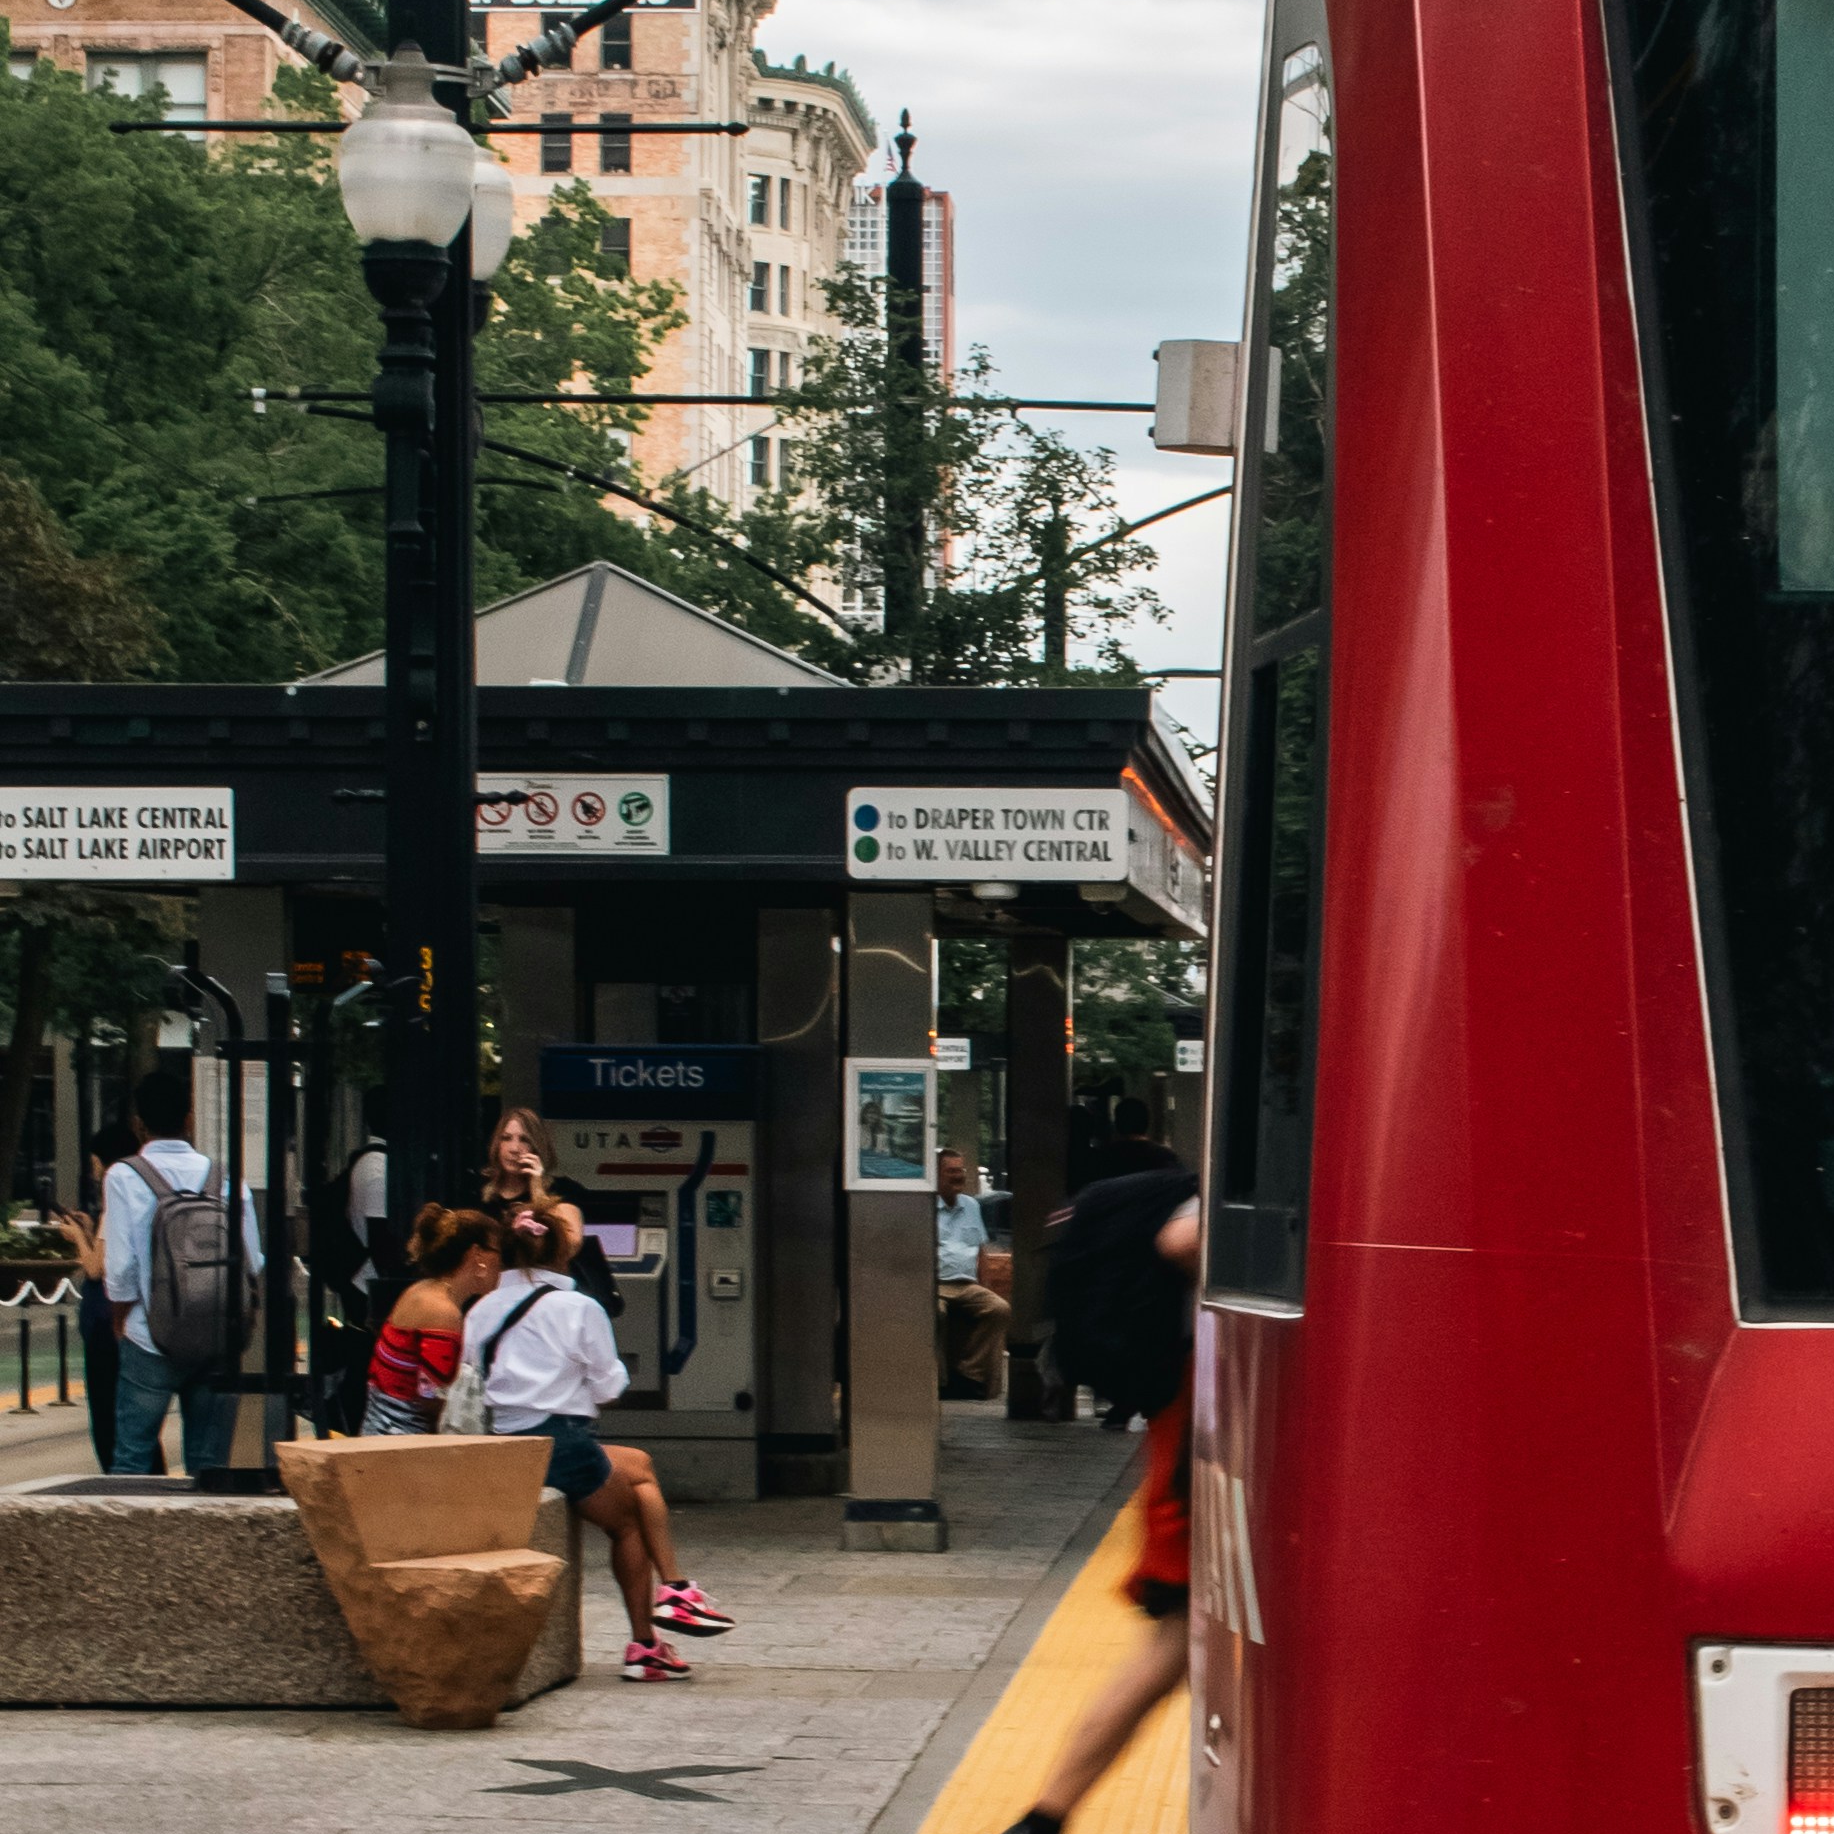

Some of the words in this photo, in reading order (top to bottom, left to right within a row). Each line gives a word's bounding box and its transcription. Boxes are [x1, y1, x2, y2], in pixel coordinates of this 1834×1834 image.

[22, 806, 68, 829] SALT
[76, 806, 129, 829] LAKE
[137, 806, 230, 829] CENTRAL
[887, 811, 908, 829] to
[914, 807, 995, 830] DRAPER
[1000, 808, 1066, 830] TOWN
[1072, 809, 1111, 831] CTR
[22, 837, 69, 860] SALT
[76, 837, 129, 860] LAKE
[137, 837, 227, 860] AIRPORT
[887, 842, 907, 861] to
[913, 839, 939, 861] W.
[945, 839, 1018, 862] VALLEY
[1023, 839, 1113, 862] CENTRAL
[588, 1057, 705, 1088] Tickets
